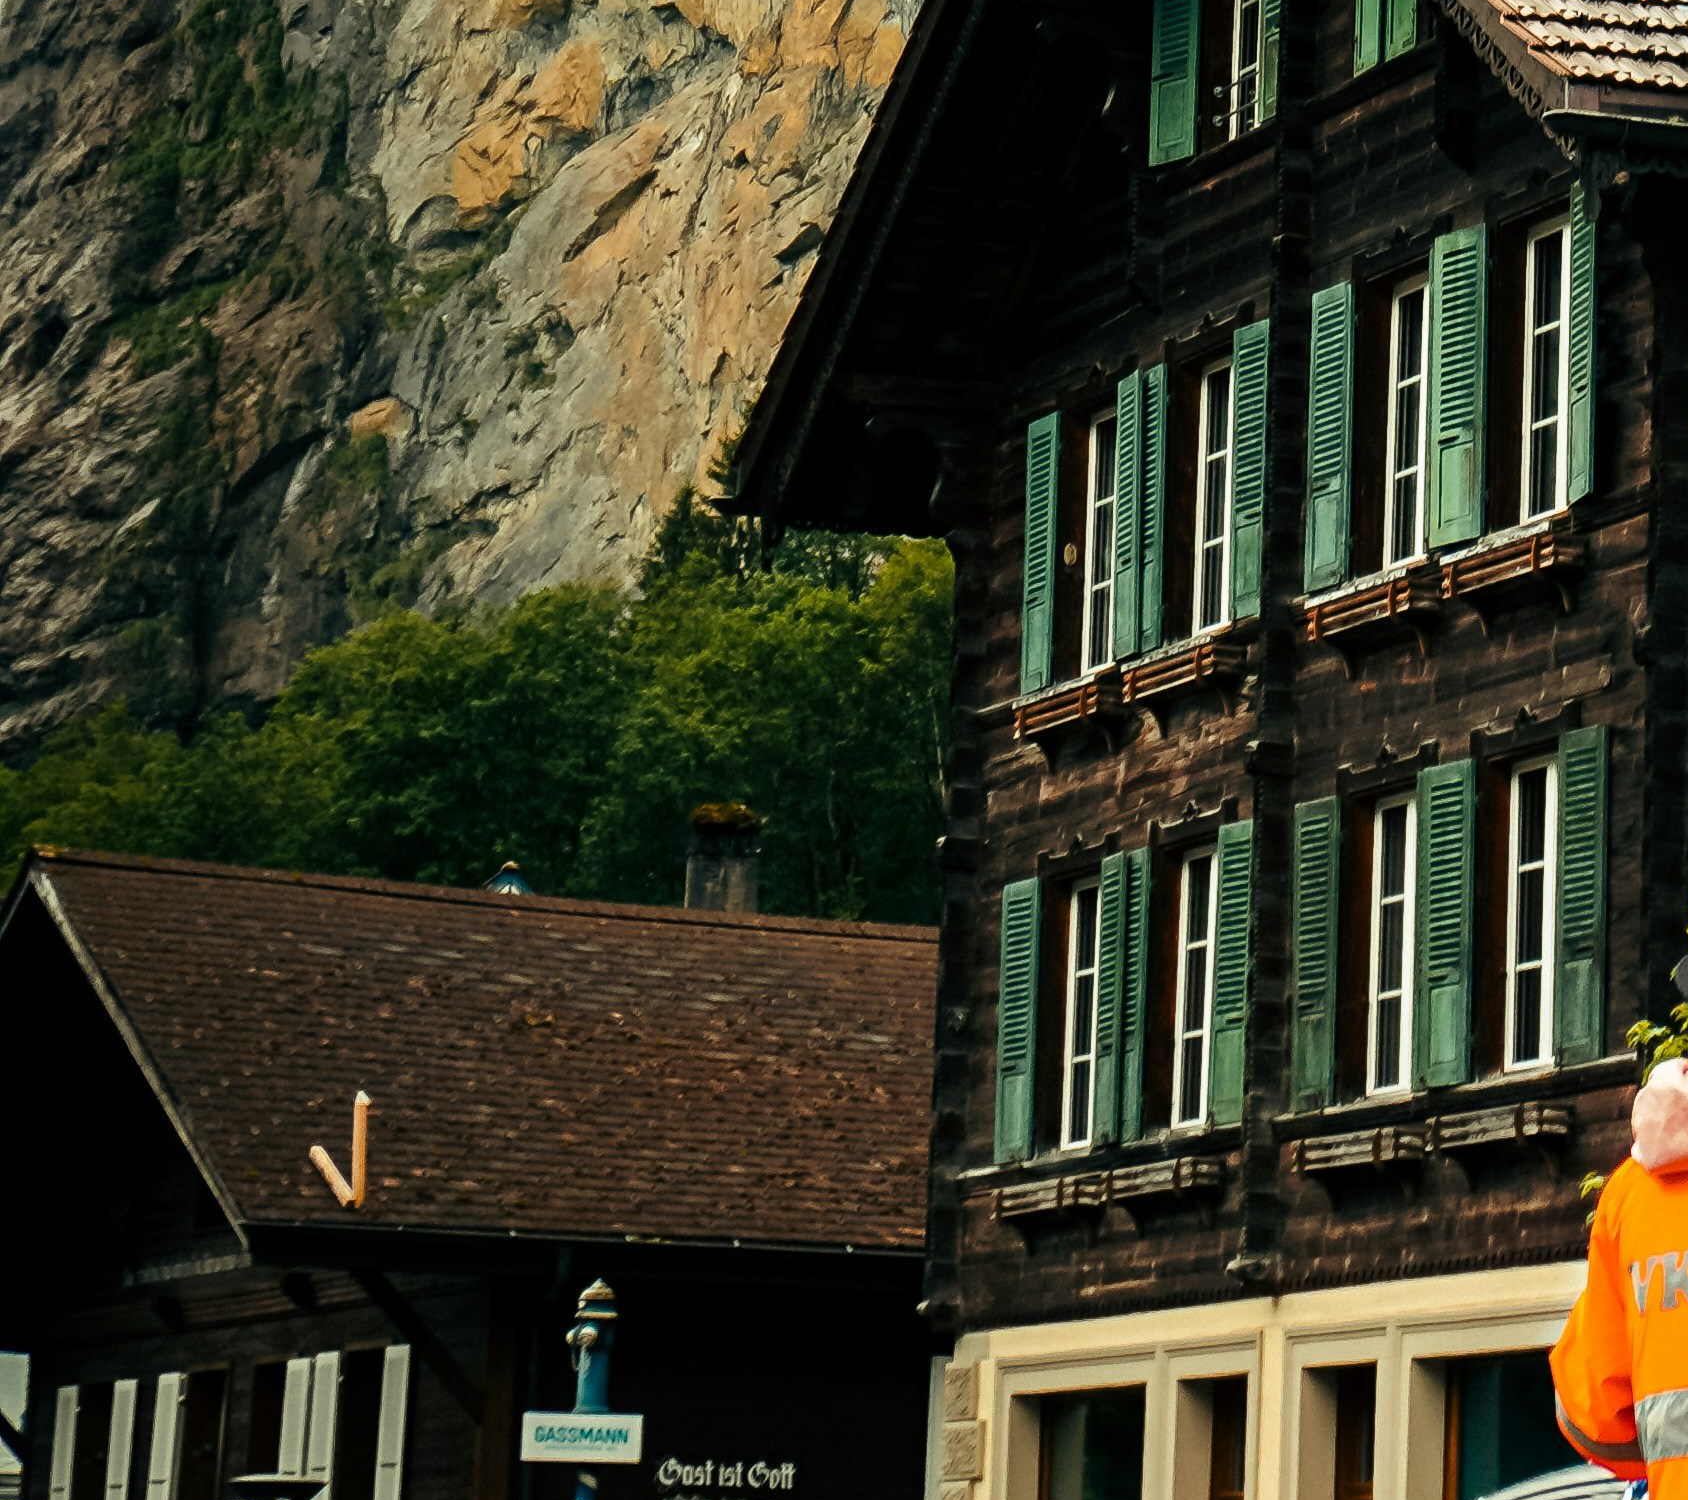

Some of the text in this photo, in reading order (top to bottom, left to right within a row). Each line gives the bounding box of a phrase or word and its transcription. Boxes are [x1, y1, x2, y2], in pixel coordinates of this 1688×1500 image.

[534, 1425, 629, 1443] GASSMANN
[658, 1458, 797, 1490] Gast ist Gott
